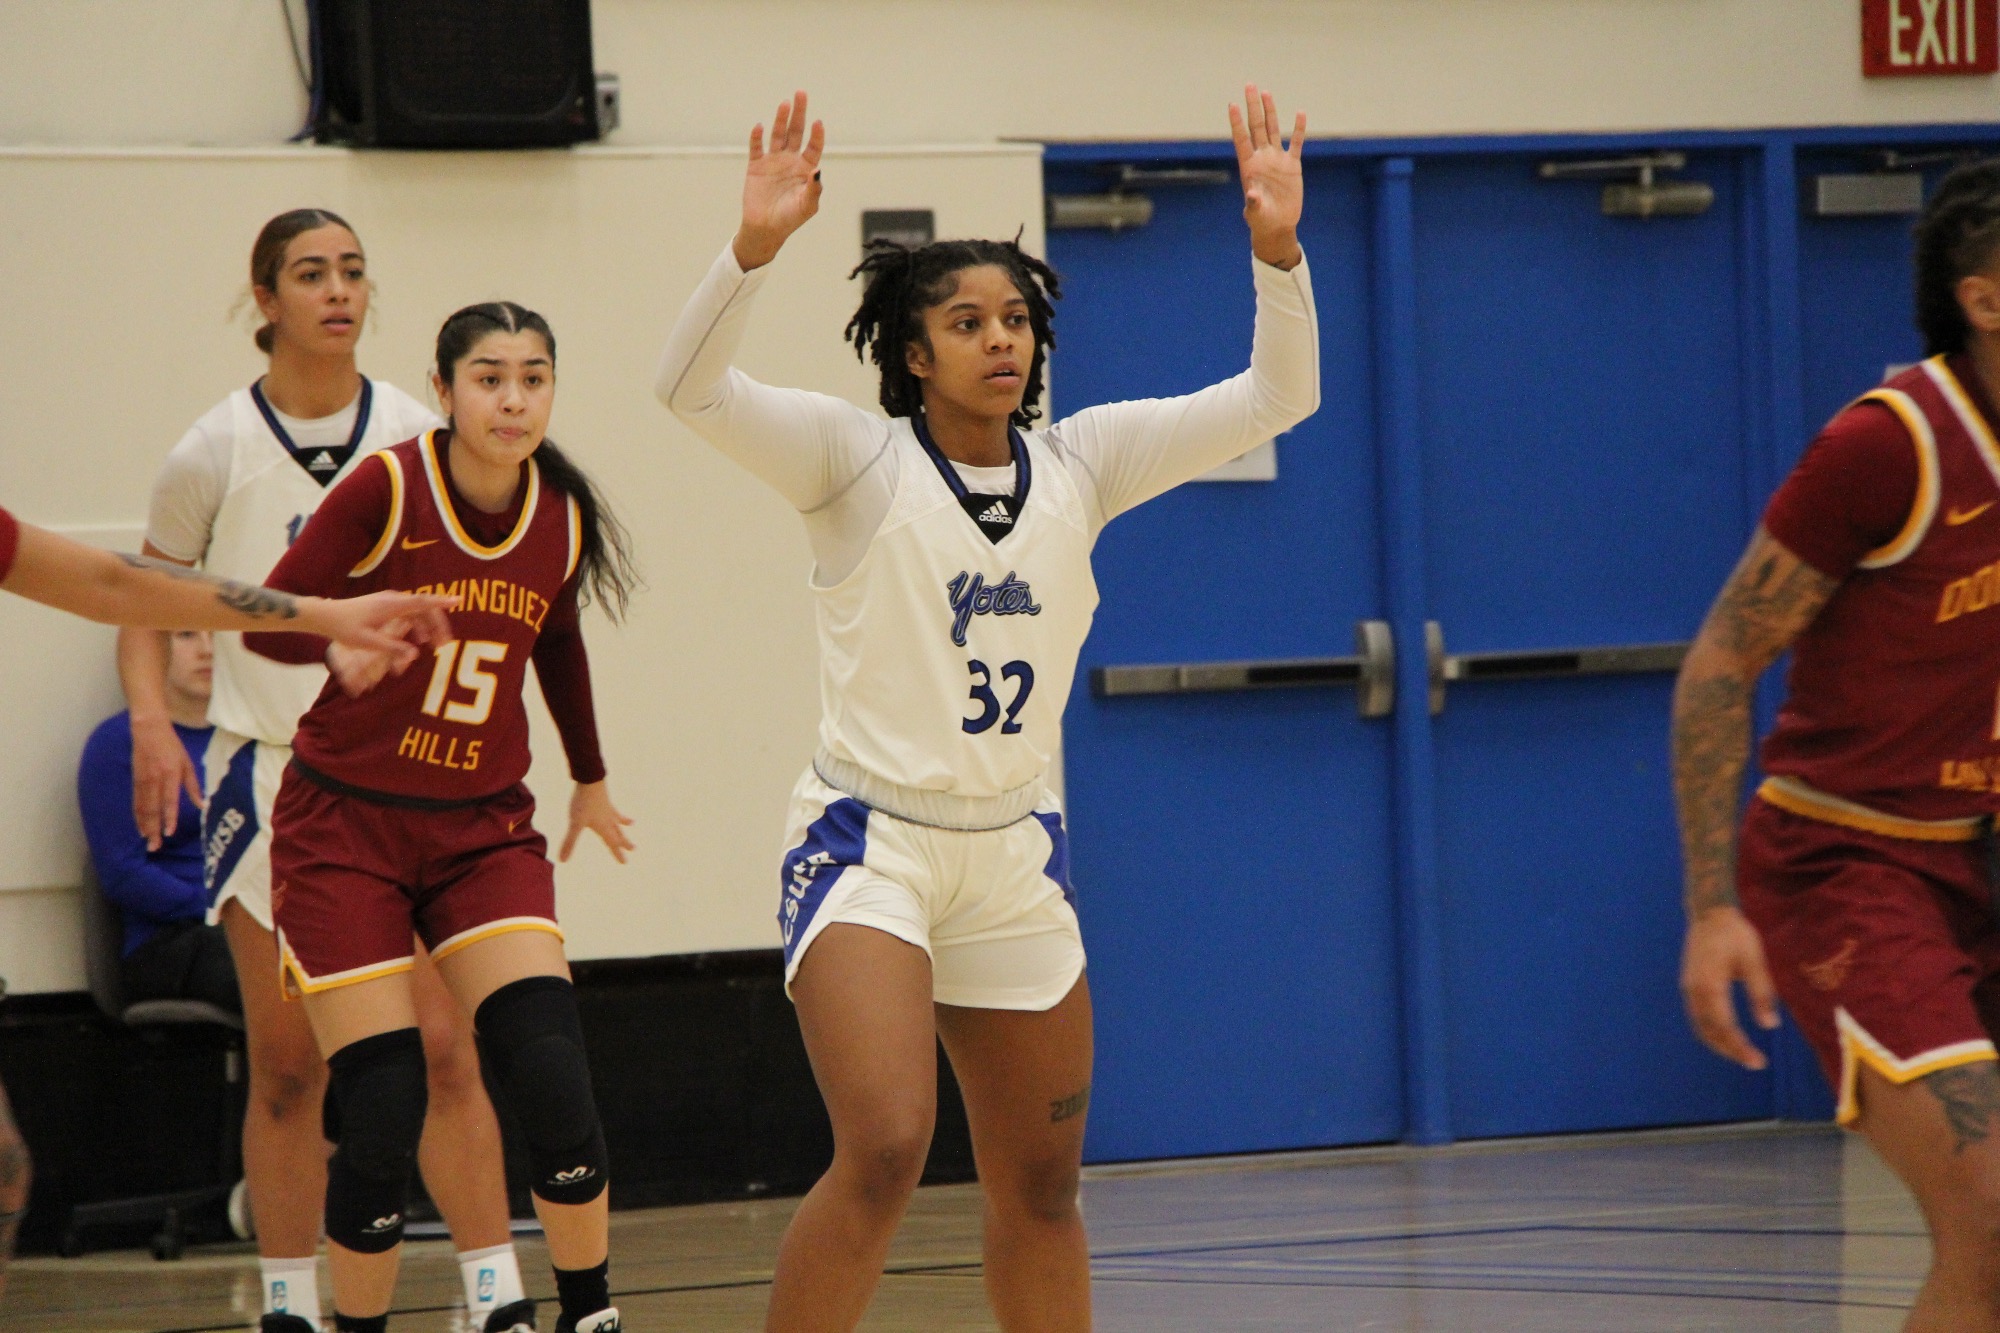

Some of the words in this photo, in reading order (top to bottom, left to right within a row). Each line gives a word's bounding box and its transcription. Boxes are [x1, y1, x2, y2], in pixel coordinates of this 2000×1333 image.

[979, 514, 1013, 524] adidas
[947, 571, 1042, 647] Yotes
[421, 639, 510, 725] 15
[962, 659, 1035, 735] 32
[398, 725, 483, 770] HILLS
